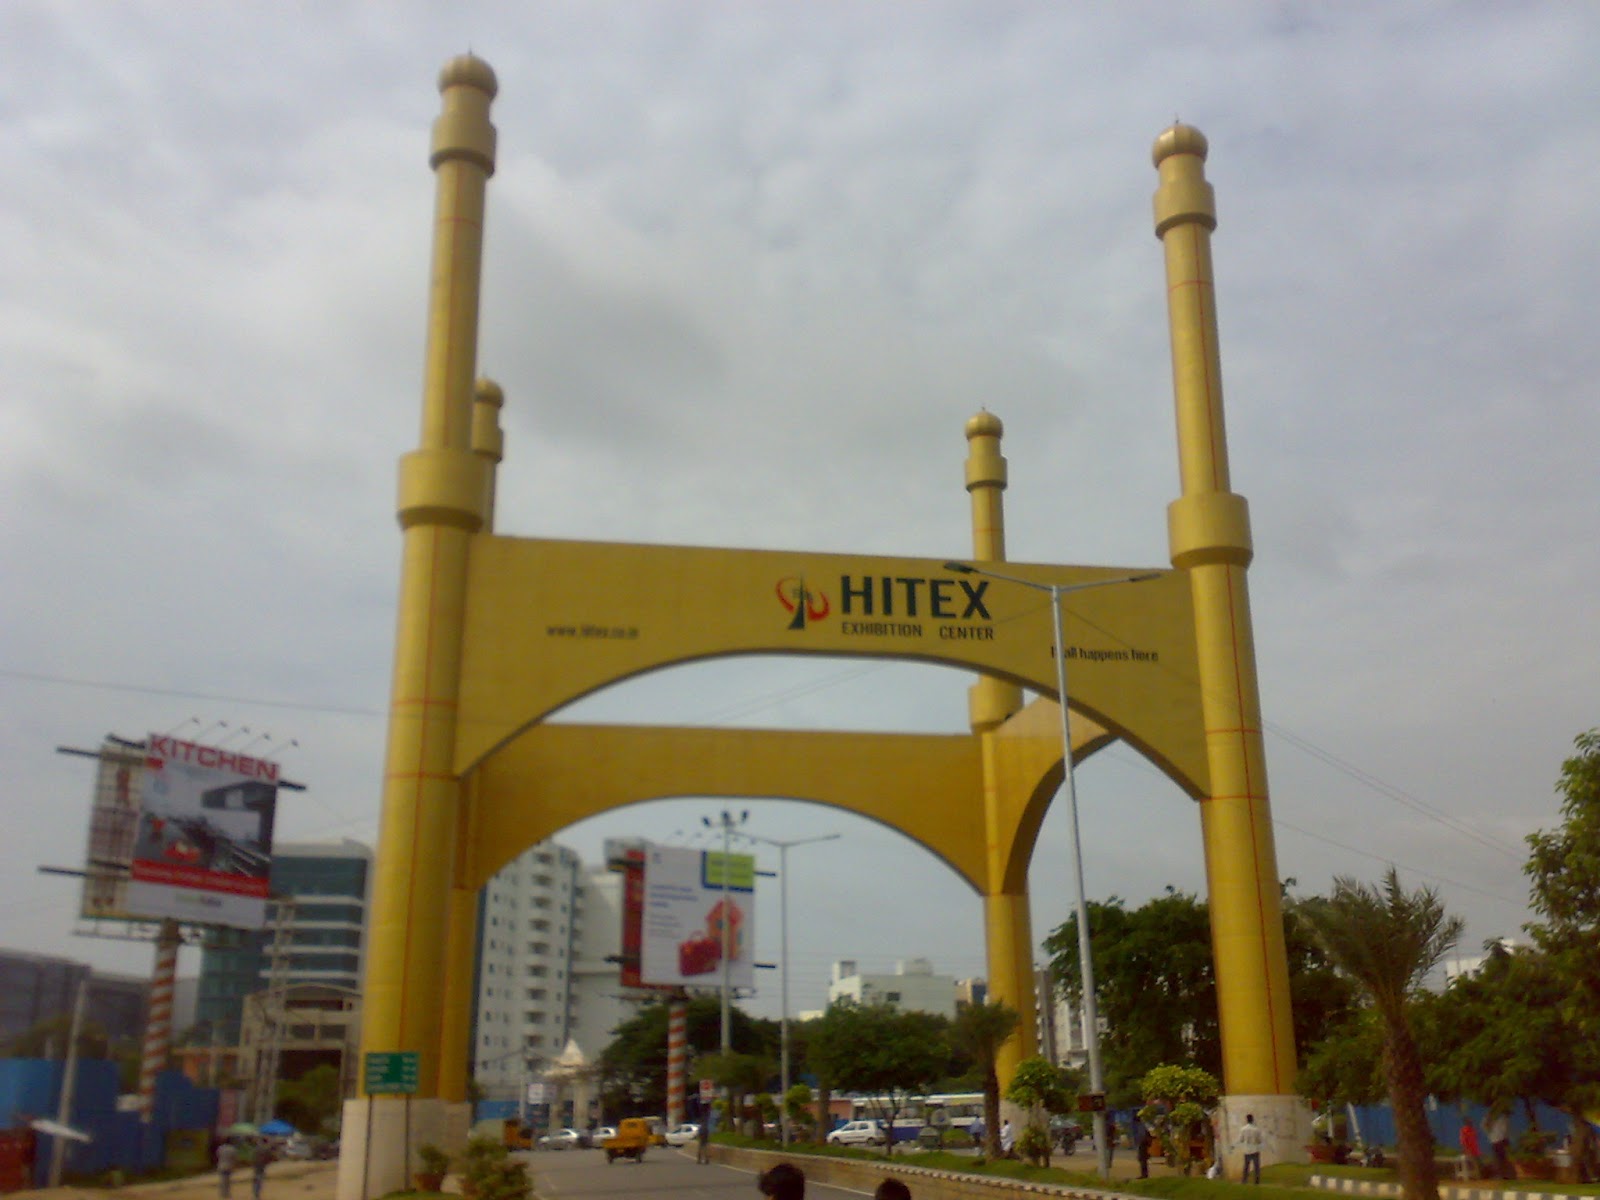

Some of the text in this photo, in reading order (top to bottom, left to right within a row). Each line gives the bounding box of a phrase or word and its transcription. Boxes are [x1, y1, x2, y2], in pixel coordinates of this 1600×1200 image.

[841, 575, 991, 620] HITEX
[842, 622, 994, 640] EXHIBITION CENTER
[1079, 648, 1129, 662] happens
[1131, 650, 1159, 662] here
[151, 734, 279, 780] KITCHEN
